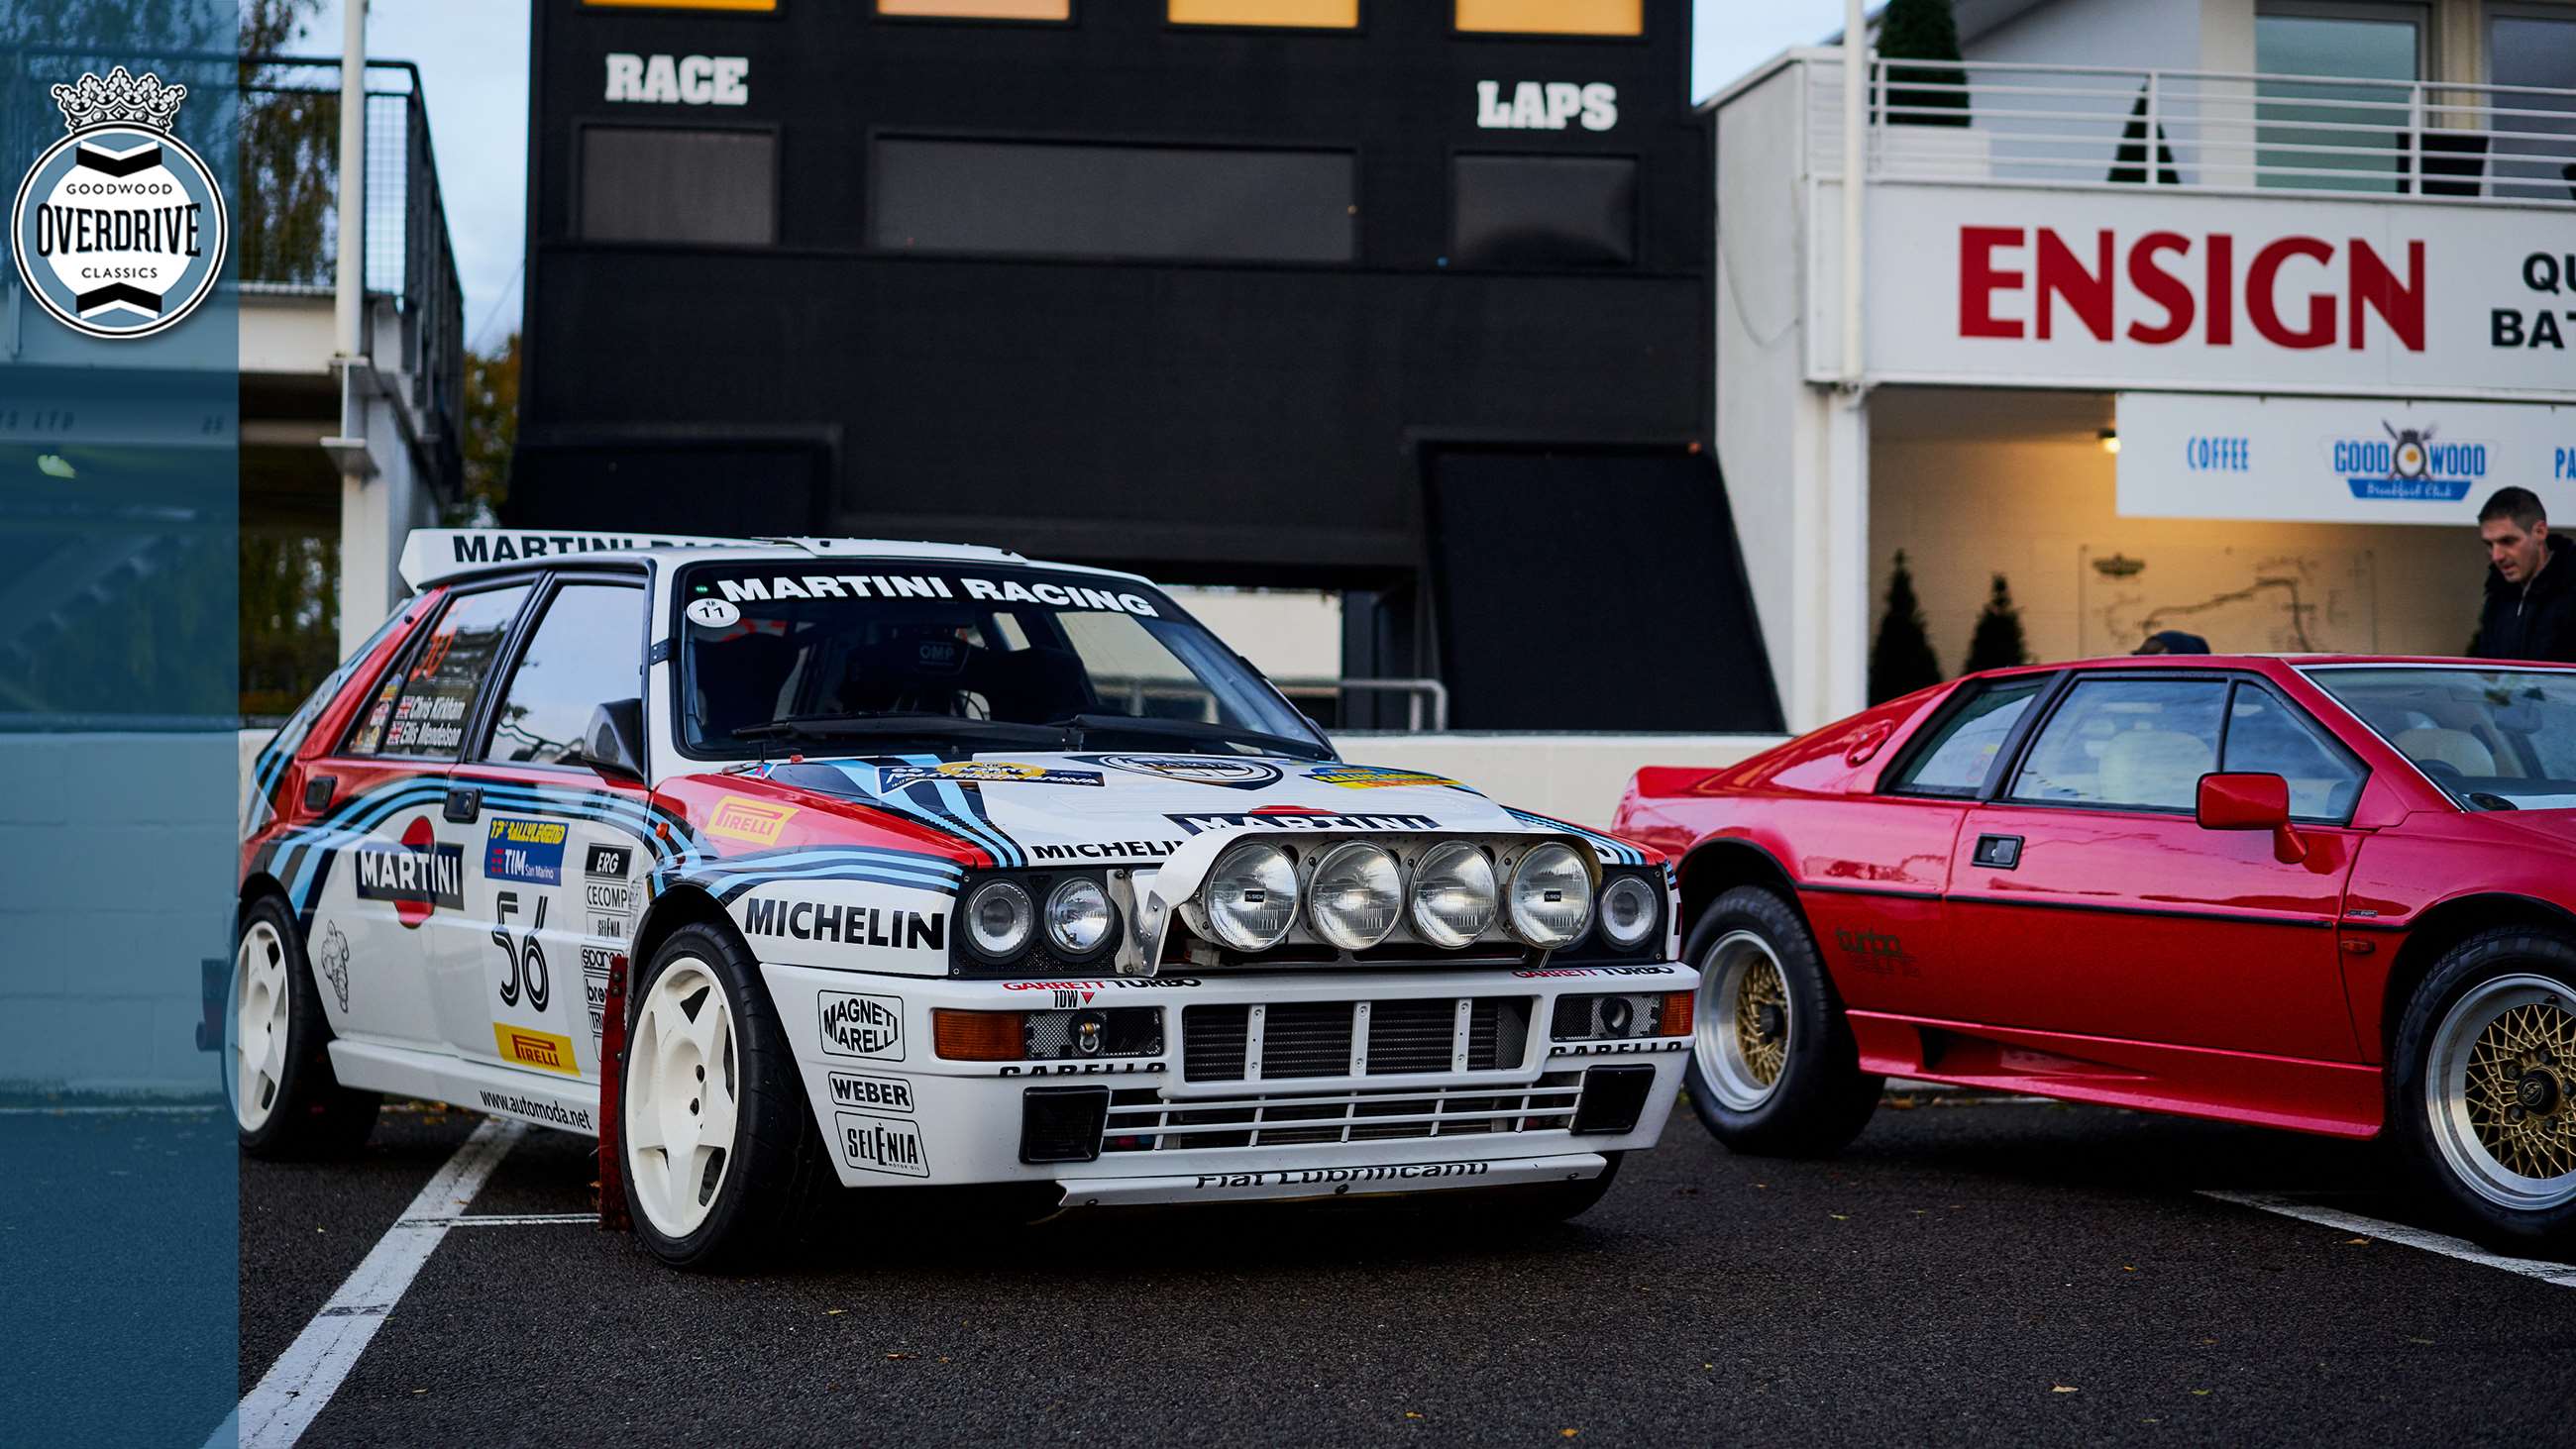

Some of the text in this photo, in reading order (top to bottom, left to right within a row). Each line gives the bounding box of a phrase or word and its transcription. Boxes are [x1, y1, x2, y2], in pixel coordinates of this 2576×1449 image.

[605, 53, 748, 105] RACE
[1476, 80, 1618, 131] LAPS
[1958, 225, 2424, 353] ENSIGN
[2187, 436, 2250, 472] COFFEE
[2333, 441, 2486, 475] GOOD WOOD
[717, 575, 1159, 617] MARTINI RACING
[715, 803, 782, 837] PIRELLI
[1184, 816, 1435, 830] MARTINI
[504, 848, 527, 876] TIM
[595, 852, 619, 874] ERG
[1030, 841, 1184, 859] MICHELI
[361, 849, 459, 895] MARTINI
[587, 885, 627, 908] CECOMP
[745, 897, 944, 951] MICHELIN
[491, 891, 549, 1012] 56
[1002, 979, 1202, 990] GARRETT TURBO
[1512, 967, 1675, 979] GARRETT TURBO
[1053, 989, 1078, 1008] TOW
[511, 1034, 560, 1068] PIRELLI
[831, 1079, 910, 1106] WEBER
[481, 1089, 592, 1131] www.automoda.net
[1196, 1172, 1265, 1189] Fiat
